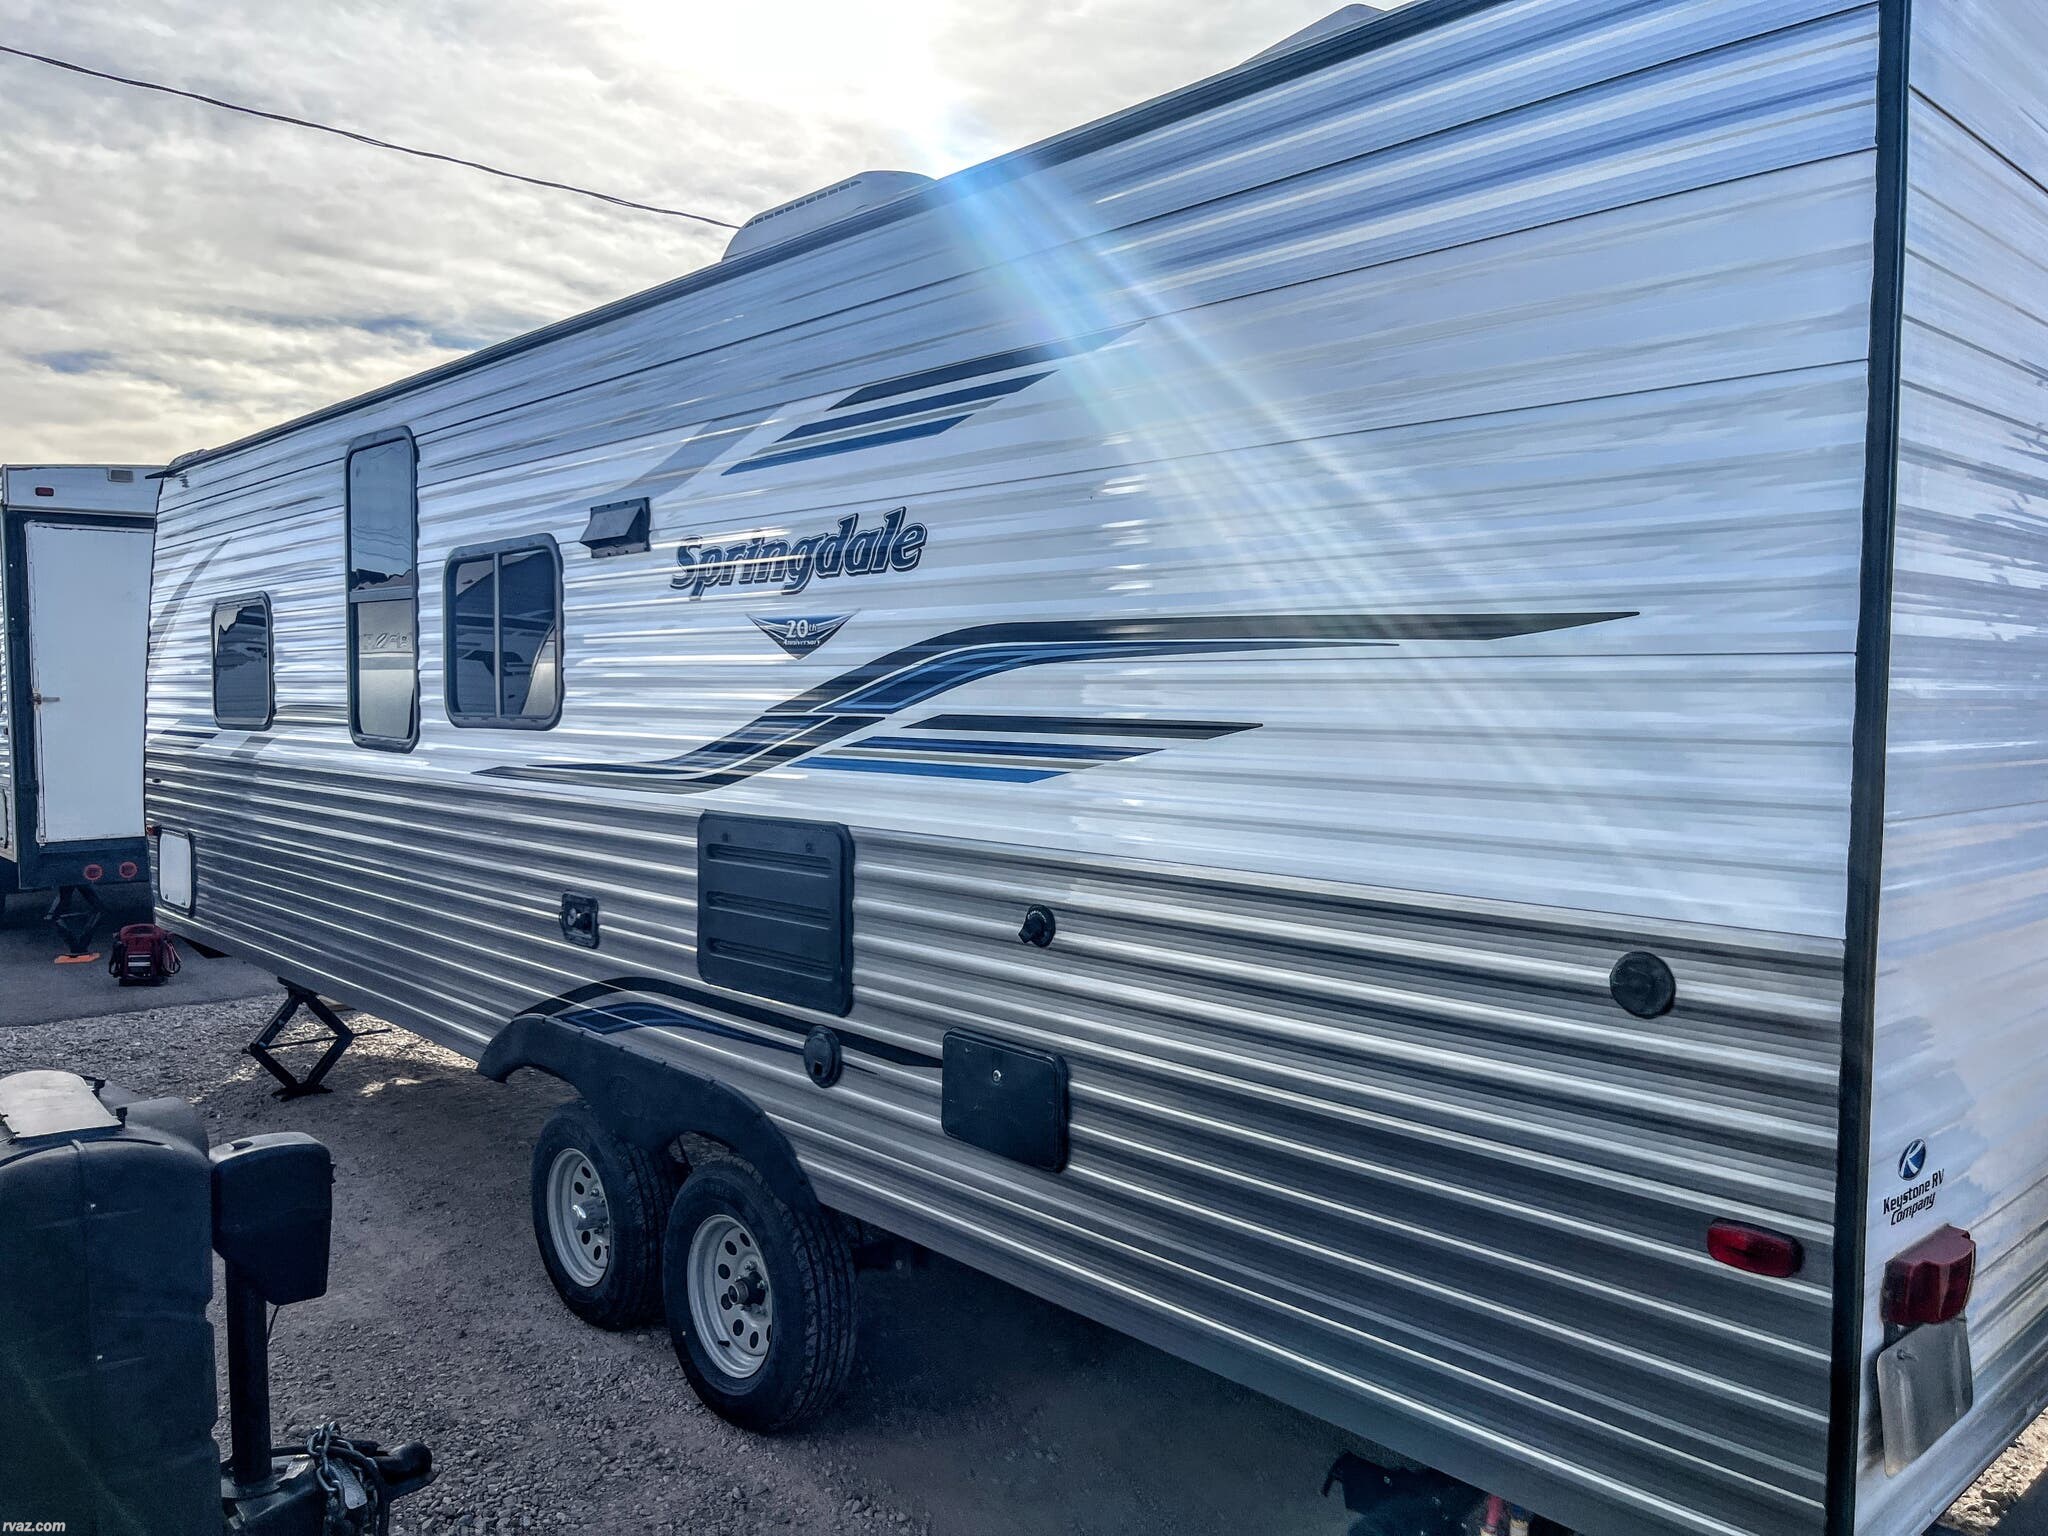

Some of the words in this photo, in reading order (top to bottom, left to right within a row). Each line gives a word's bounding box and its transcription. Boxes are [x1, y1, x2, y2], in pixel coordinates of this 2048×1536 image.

[670, 506, 928, 601] Springdale
[786, 619, 817, 638] 20th
[1883, 1181, 1931, 1215] Keystone
[1931, 1168, 1945, 1189] RV
[1890, 1192, 1936, 1226] Company
